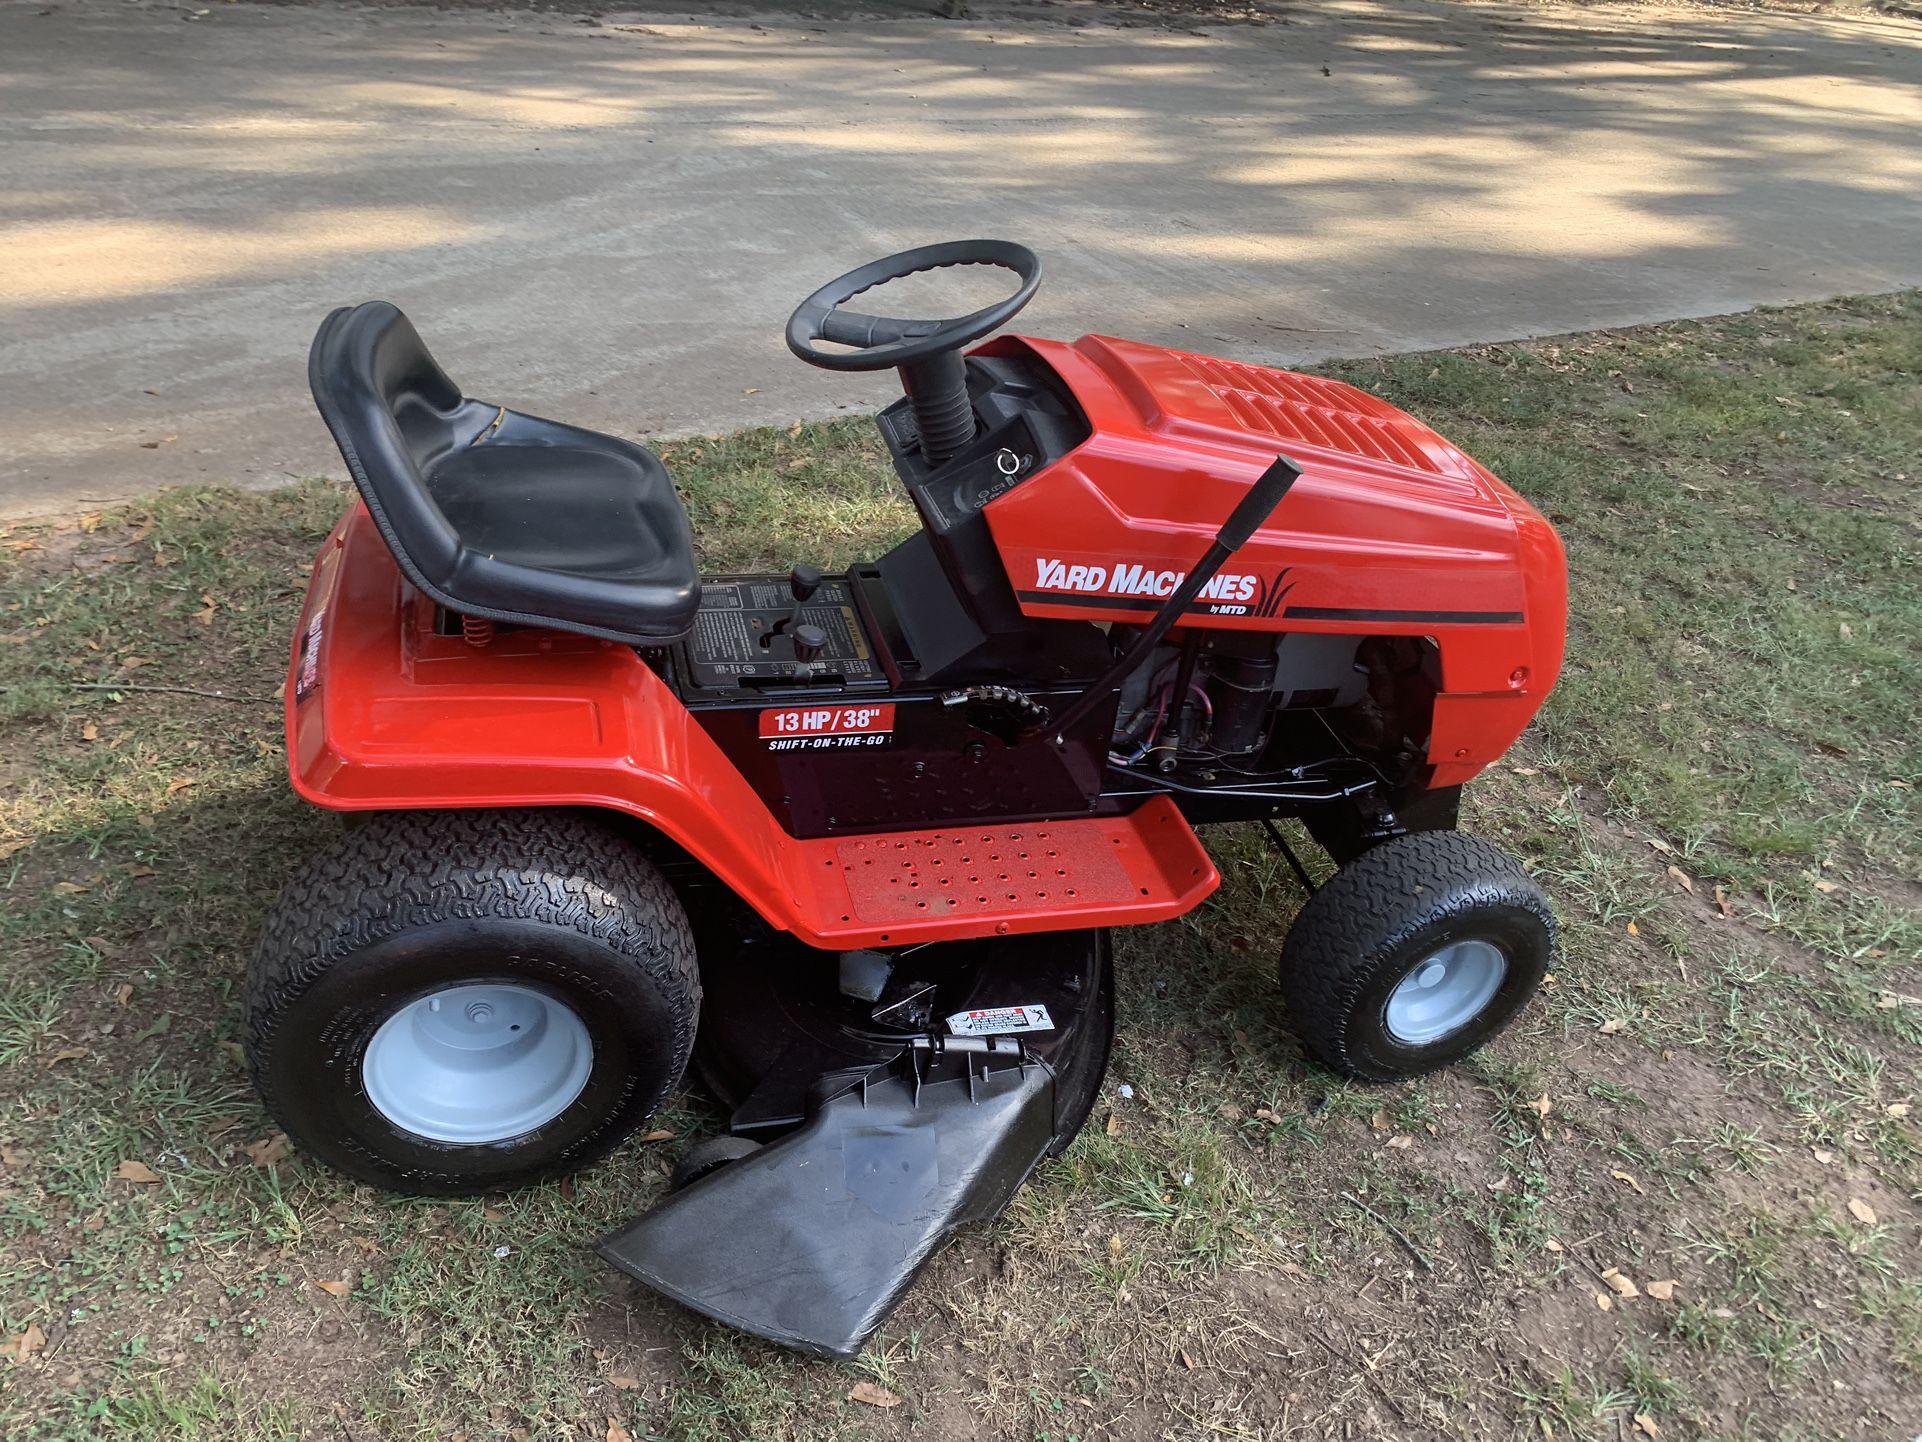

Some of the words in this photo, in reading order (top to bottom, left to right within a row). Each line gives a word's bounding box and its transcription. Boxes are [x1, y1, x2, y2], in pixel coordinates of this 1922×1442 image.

[1035, 558, 1107, 591] YARD
[1108, 563, 1257, 601] MACNES
[1209, 604, 1219, 615] by
[1219, 605, 1246, 615] MTD
[774, 712, 799, 732] 13
[768, 735, 884, 751] SHIFT-ON-THE-GO
[984, 1008, 1016, 1016] DANGER
